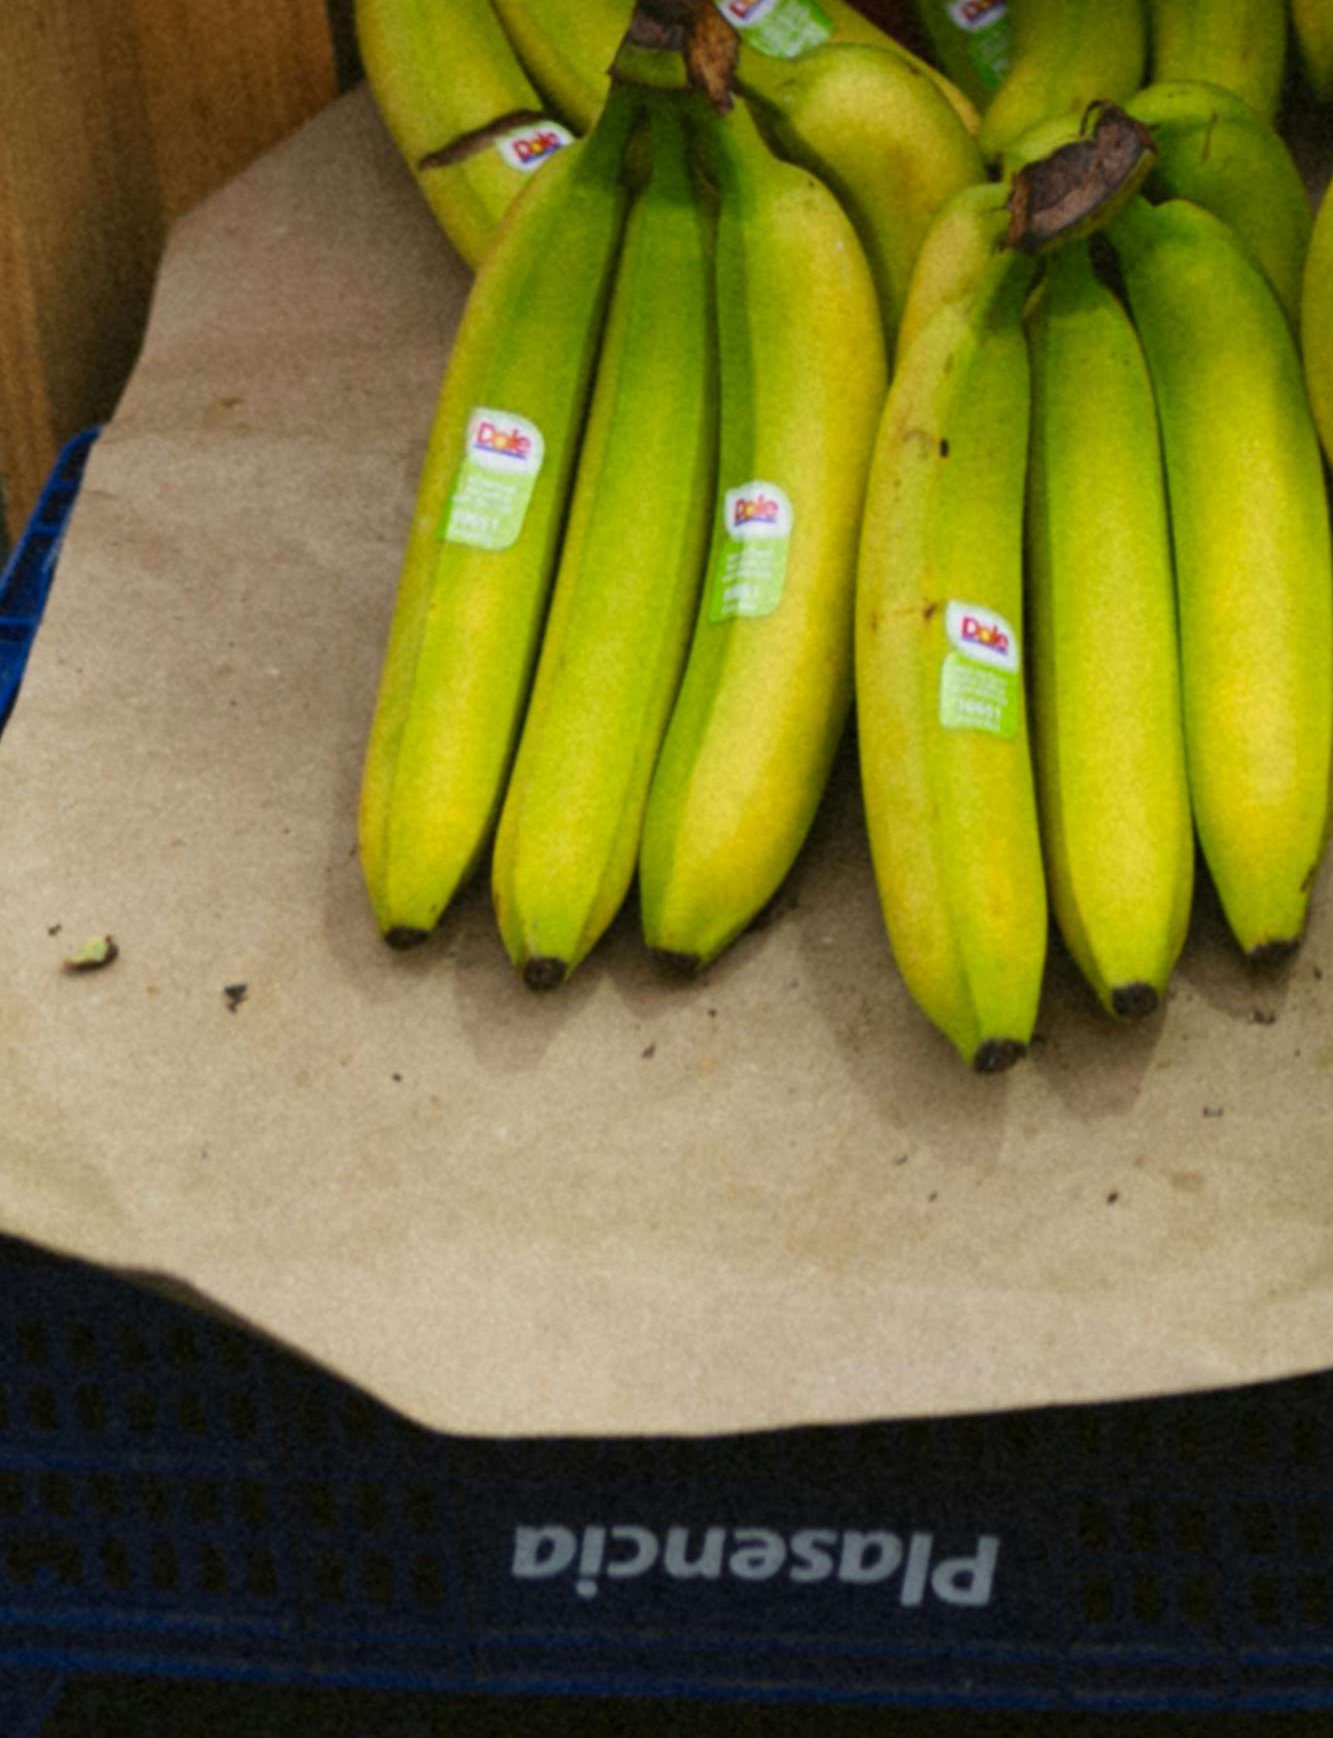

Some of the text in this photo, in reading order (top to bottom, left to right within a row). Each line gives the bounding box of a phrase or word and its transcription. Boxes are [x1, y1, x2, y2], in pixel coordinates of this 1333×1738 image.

[512, 131, 561, 162] Dole
[476, 422, 531, 450] Dole
[735, 495, 779, 522] Dole
[962, 616, 1009, 652] Dole
[512, 1526, 999, 1607] Plasencia
